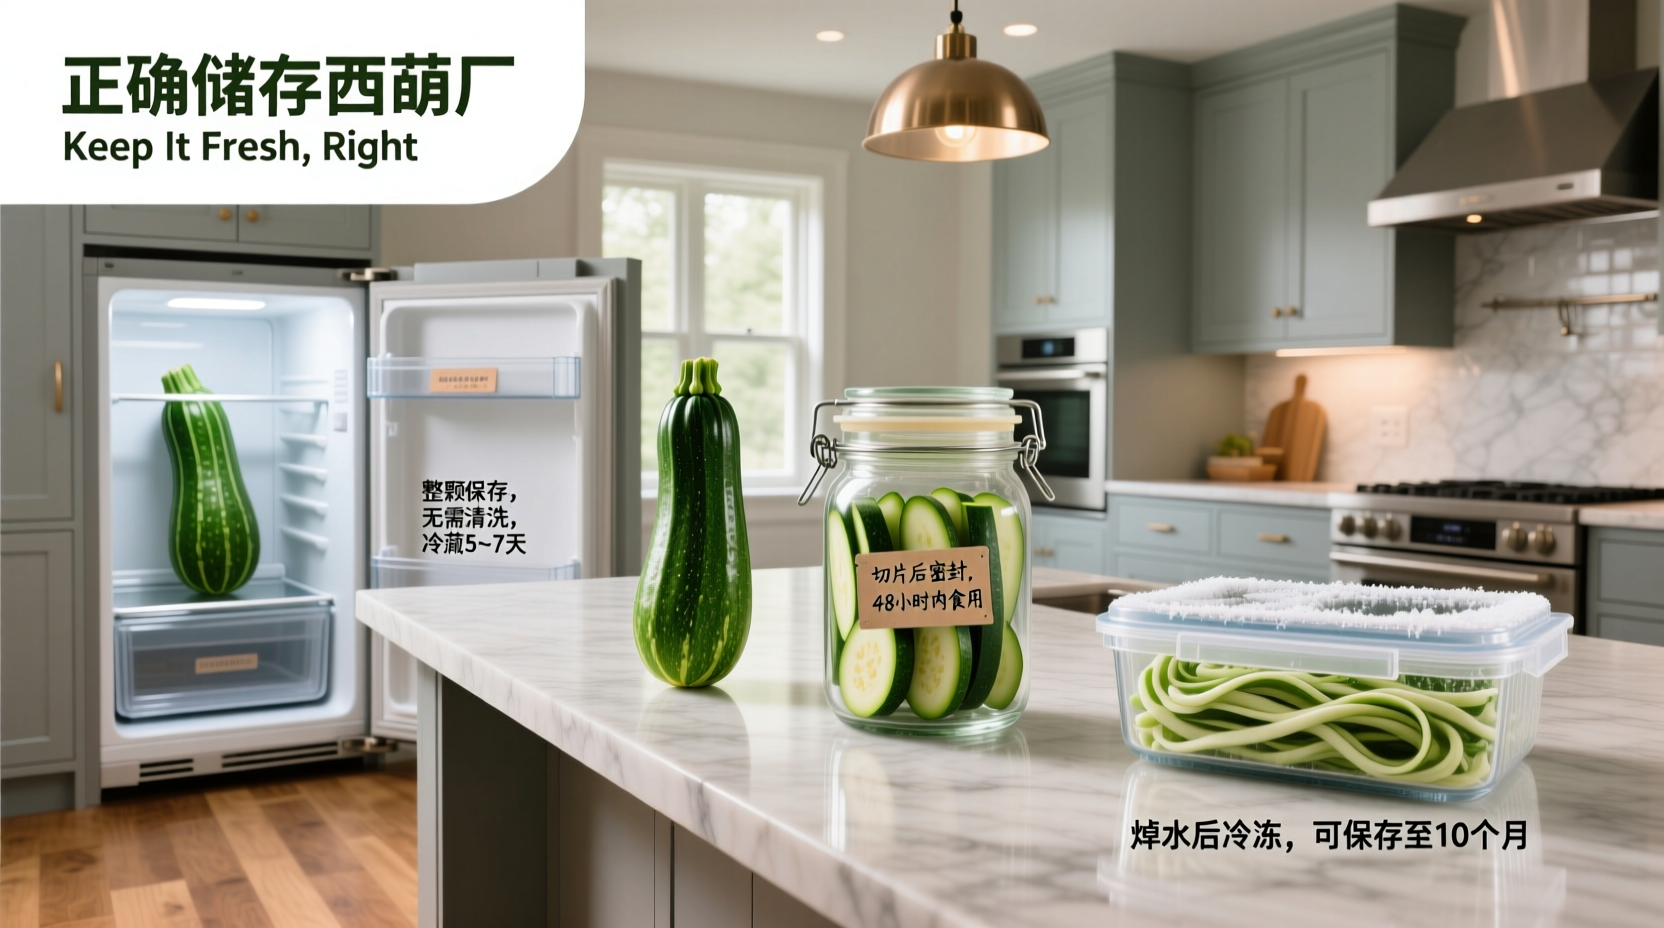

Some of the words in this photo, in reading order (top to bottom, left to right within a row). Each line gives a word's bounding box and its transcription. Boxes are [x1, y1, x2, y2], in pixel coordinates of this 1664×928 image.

[872, 588, 983, 612] 48小时内食用
